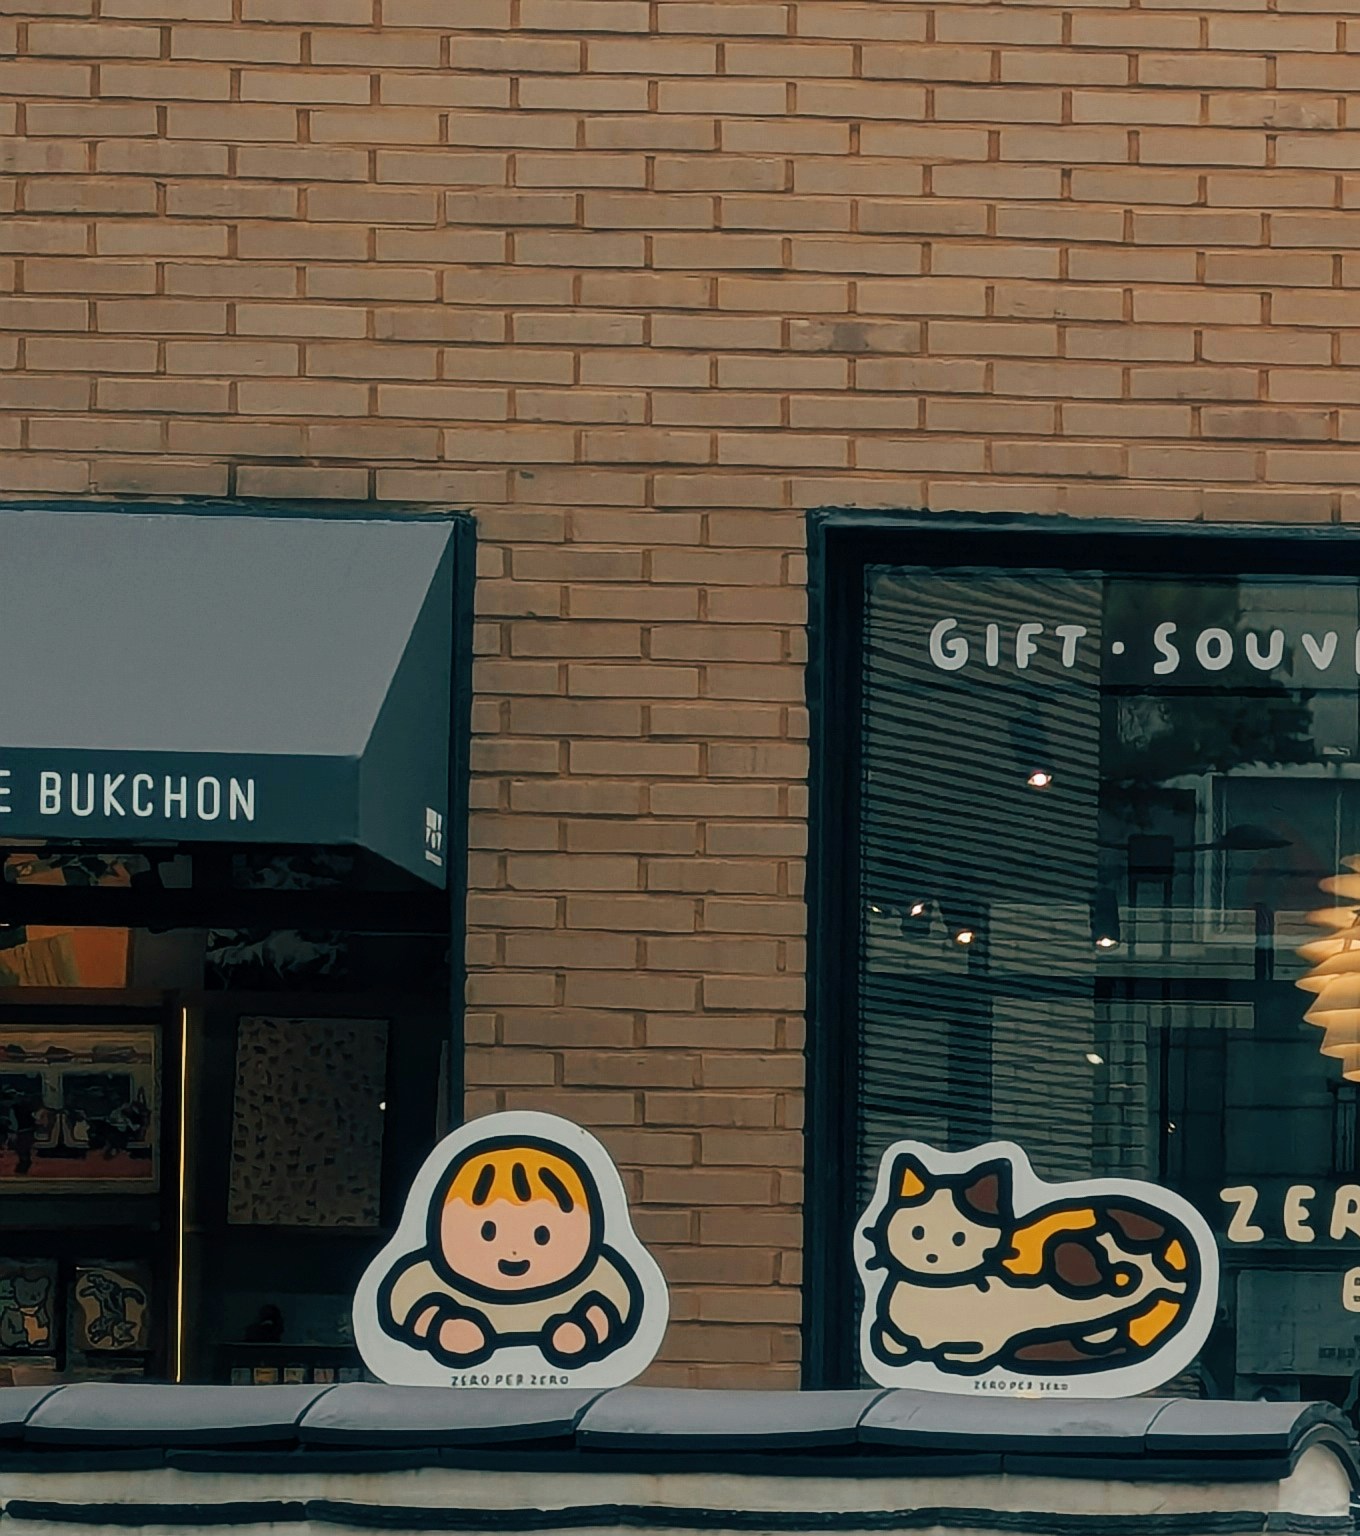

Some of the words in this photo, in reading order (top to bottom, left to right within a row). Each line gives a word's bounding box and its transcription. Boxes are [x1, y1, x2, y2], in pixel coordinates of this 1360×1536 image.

[928, 618, 1087, 671] GIFT
[39, 770, 256, 821] BUKCHON
[451, 1374, 490, 1386] ZERO
[495, 1374, 524, 1386] PER
[530, 1375, 569, 1385] ZERO
